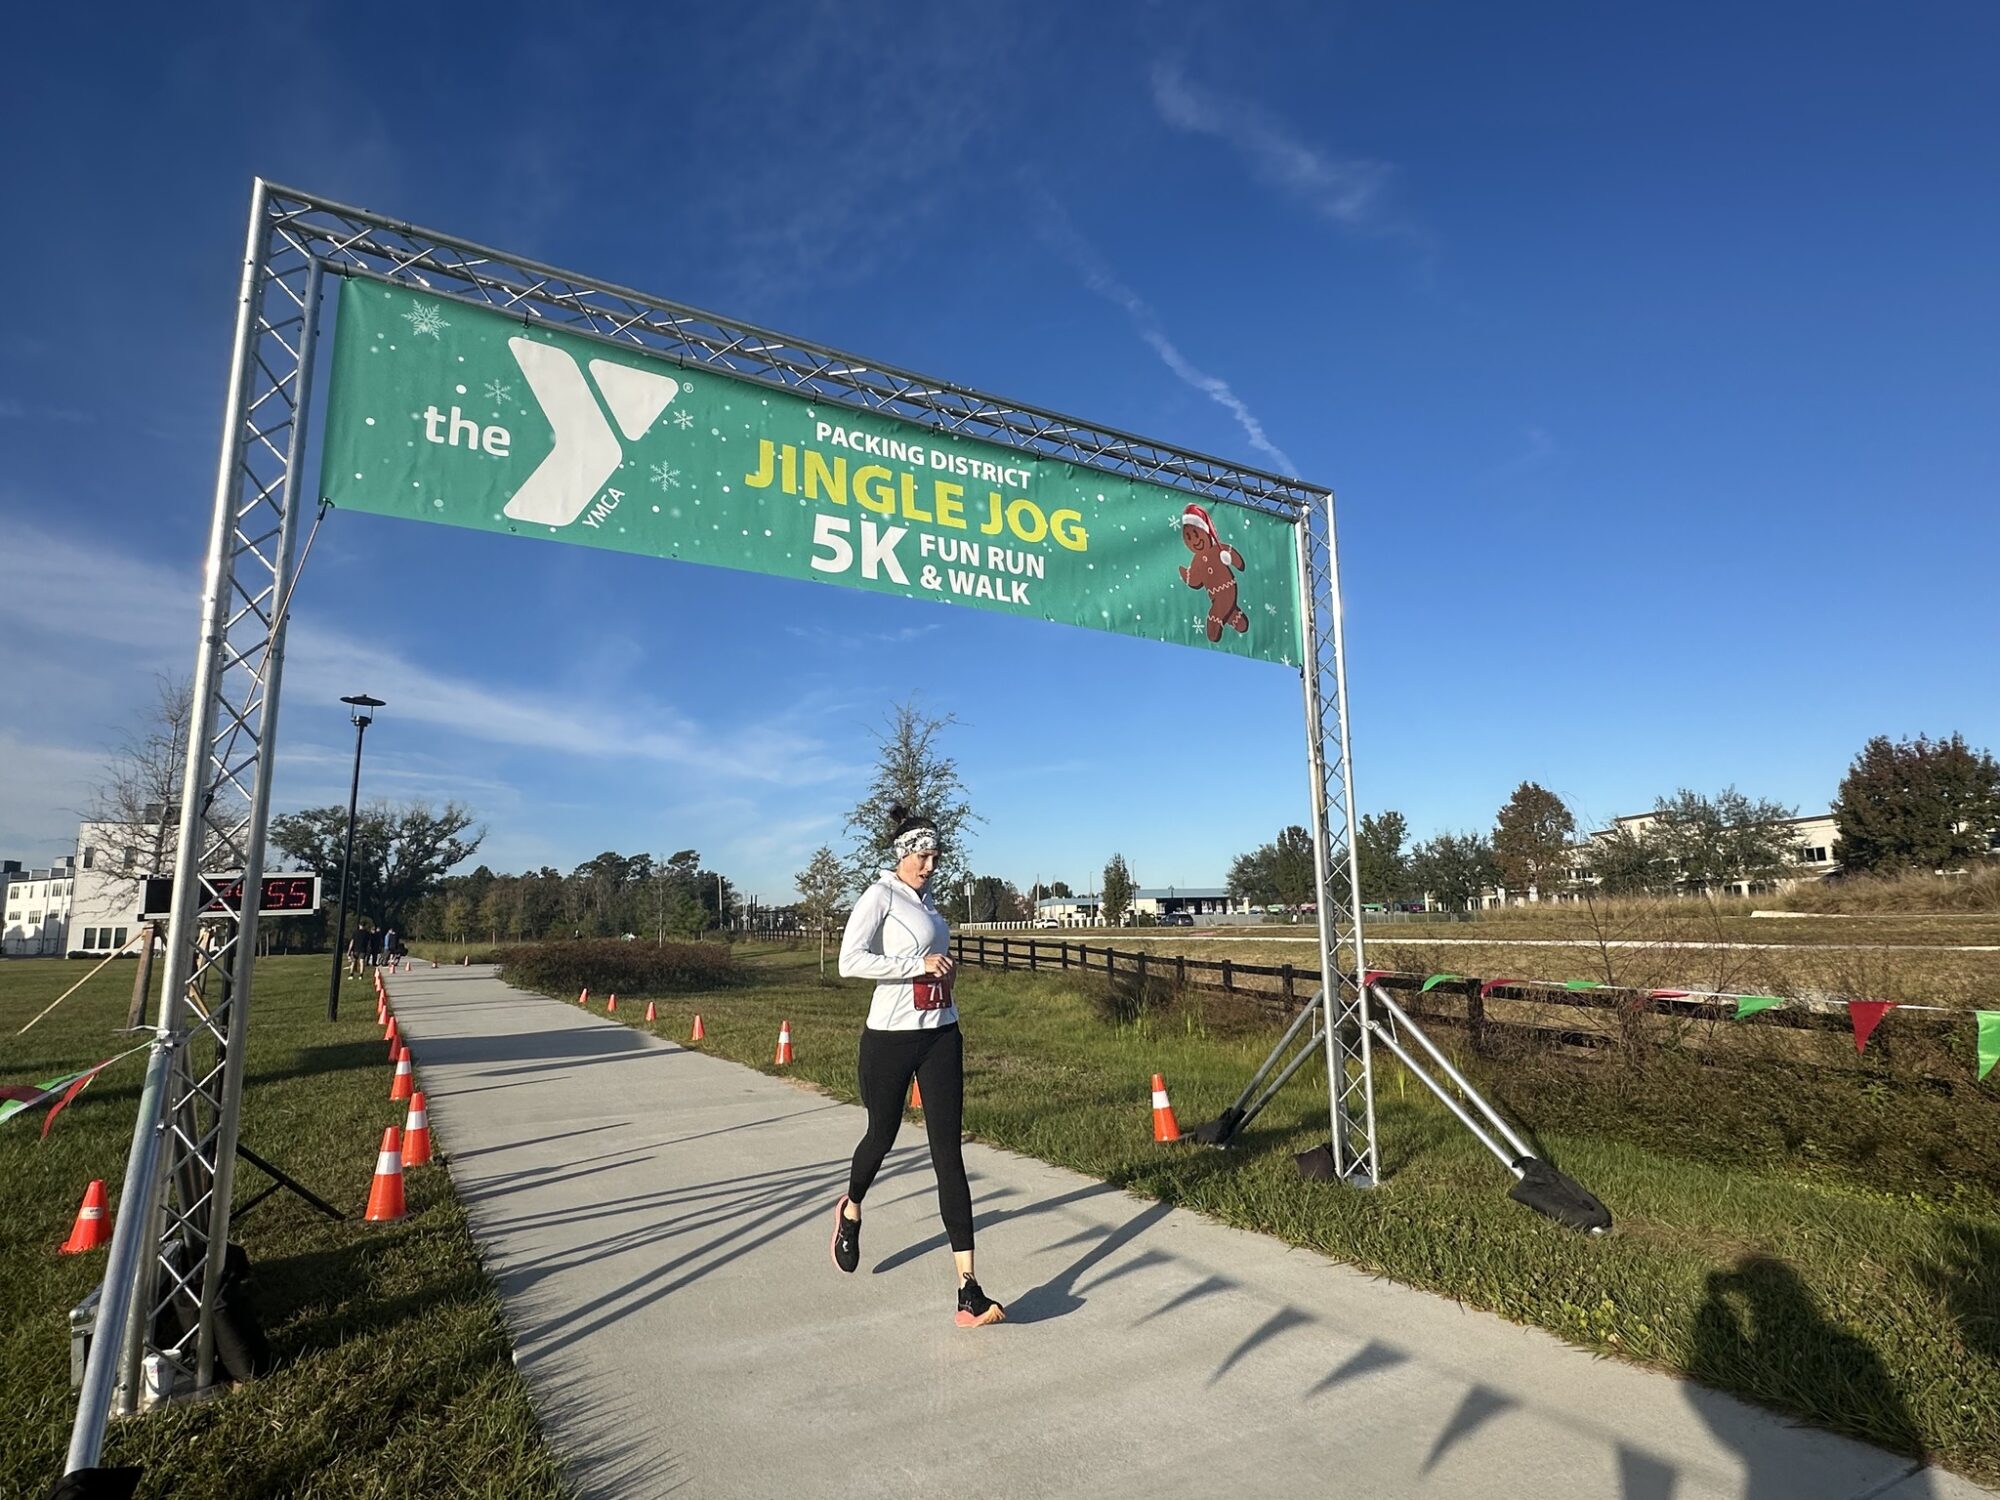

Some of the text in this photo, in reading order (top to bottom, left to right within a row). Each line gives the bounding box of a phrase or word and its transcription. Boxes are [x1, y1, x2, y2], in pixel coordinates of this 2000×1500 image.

[423, 405, 511, 457] the
[816, 421, 1032, 490] PACKING DISTRICT
[582, 486, 626, 530] YMCA
[744, 438, 1088, 552] JINGLE JOG
[810, 513, 911, 586] 5K
[919, 533, 1045, 580] FUN RUN
[919, 565, 1032, 606] & WALK
[927, 982, 943, 1001] 71
